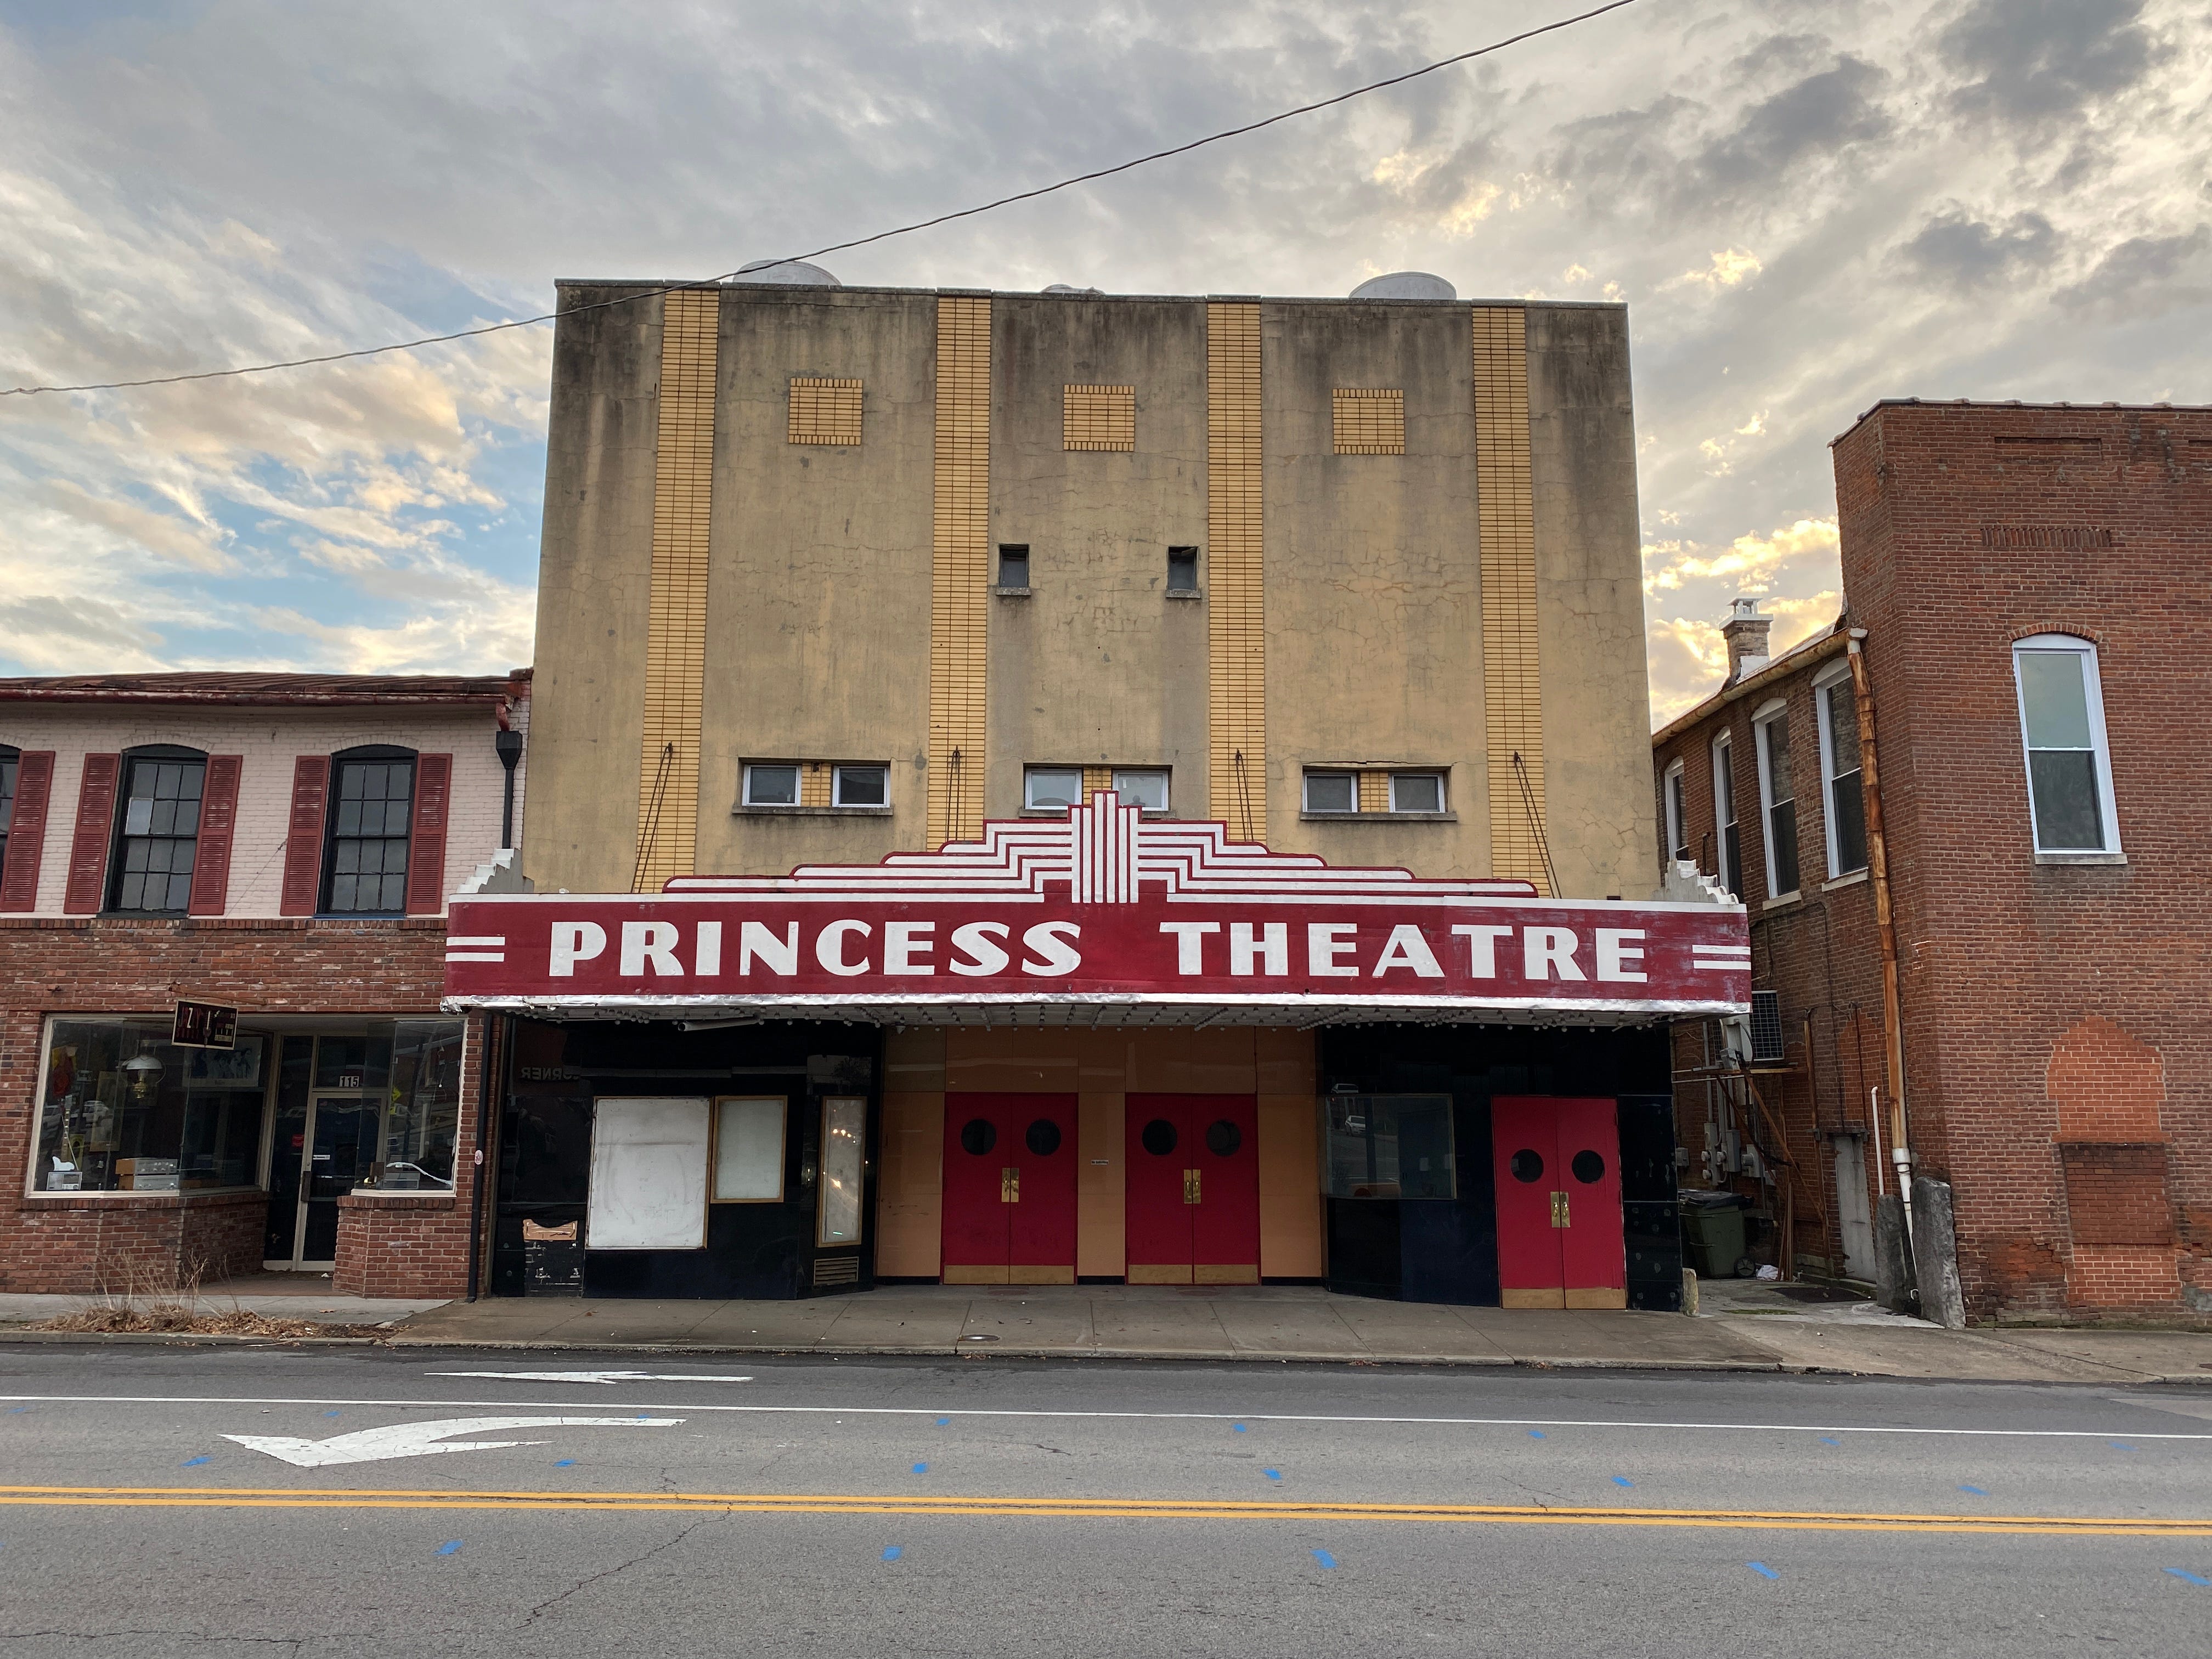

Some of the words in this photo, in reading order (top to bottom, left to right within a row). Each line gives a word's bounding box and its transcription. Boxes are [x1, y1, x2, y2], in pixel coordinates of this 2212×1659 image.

[549, 919, 1081, 977] PRINCESS
[1159, 922, 1647, 983] THEATRE
[341, 1076, 358, 1088] 115
